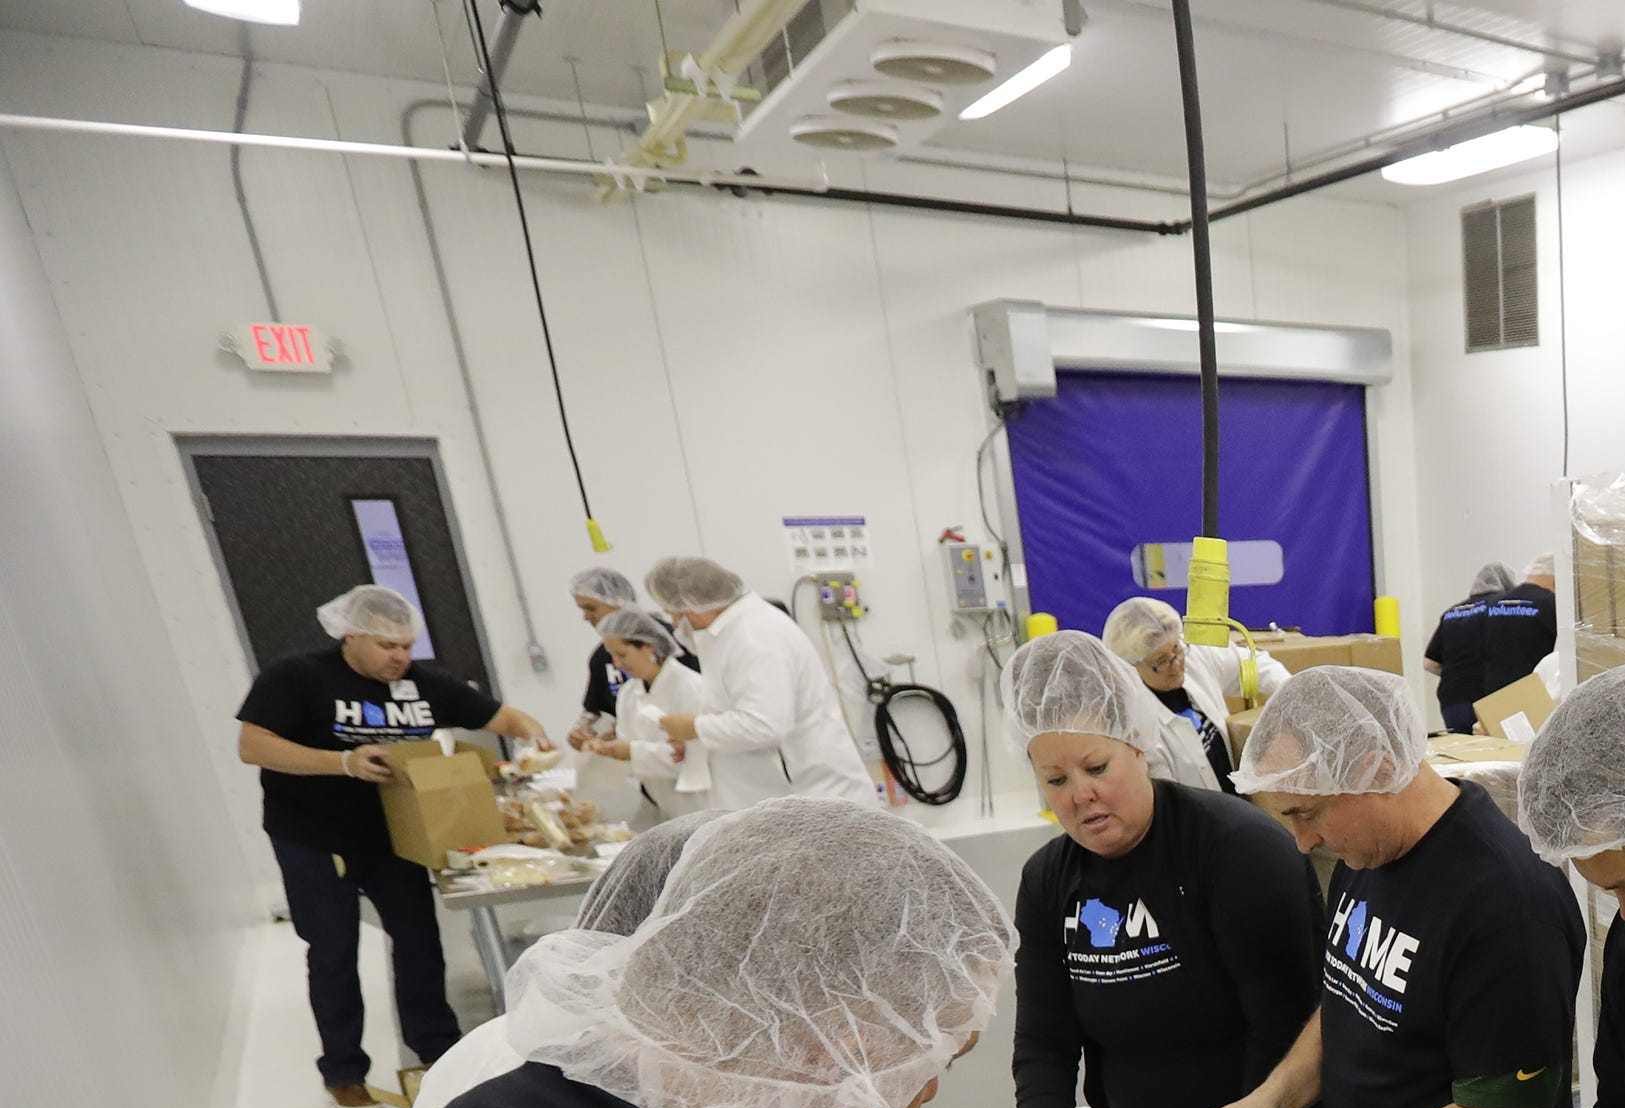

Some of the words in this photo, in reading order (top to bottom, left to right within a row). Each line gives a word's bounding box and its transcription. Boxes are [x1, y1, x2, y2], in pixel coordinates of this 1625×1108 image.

[250, 324, 315, 366] EXIT
[1488, 605, 1539, 616] Volunteer
[1073, 953, 1099, 963] TODAY
[1101, 949, 1139, 963] NETORK
